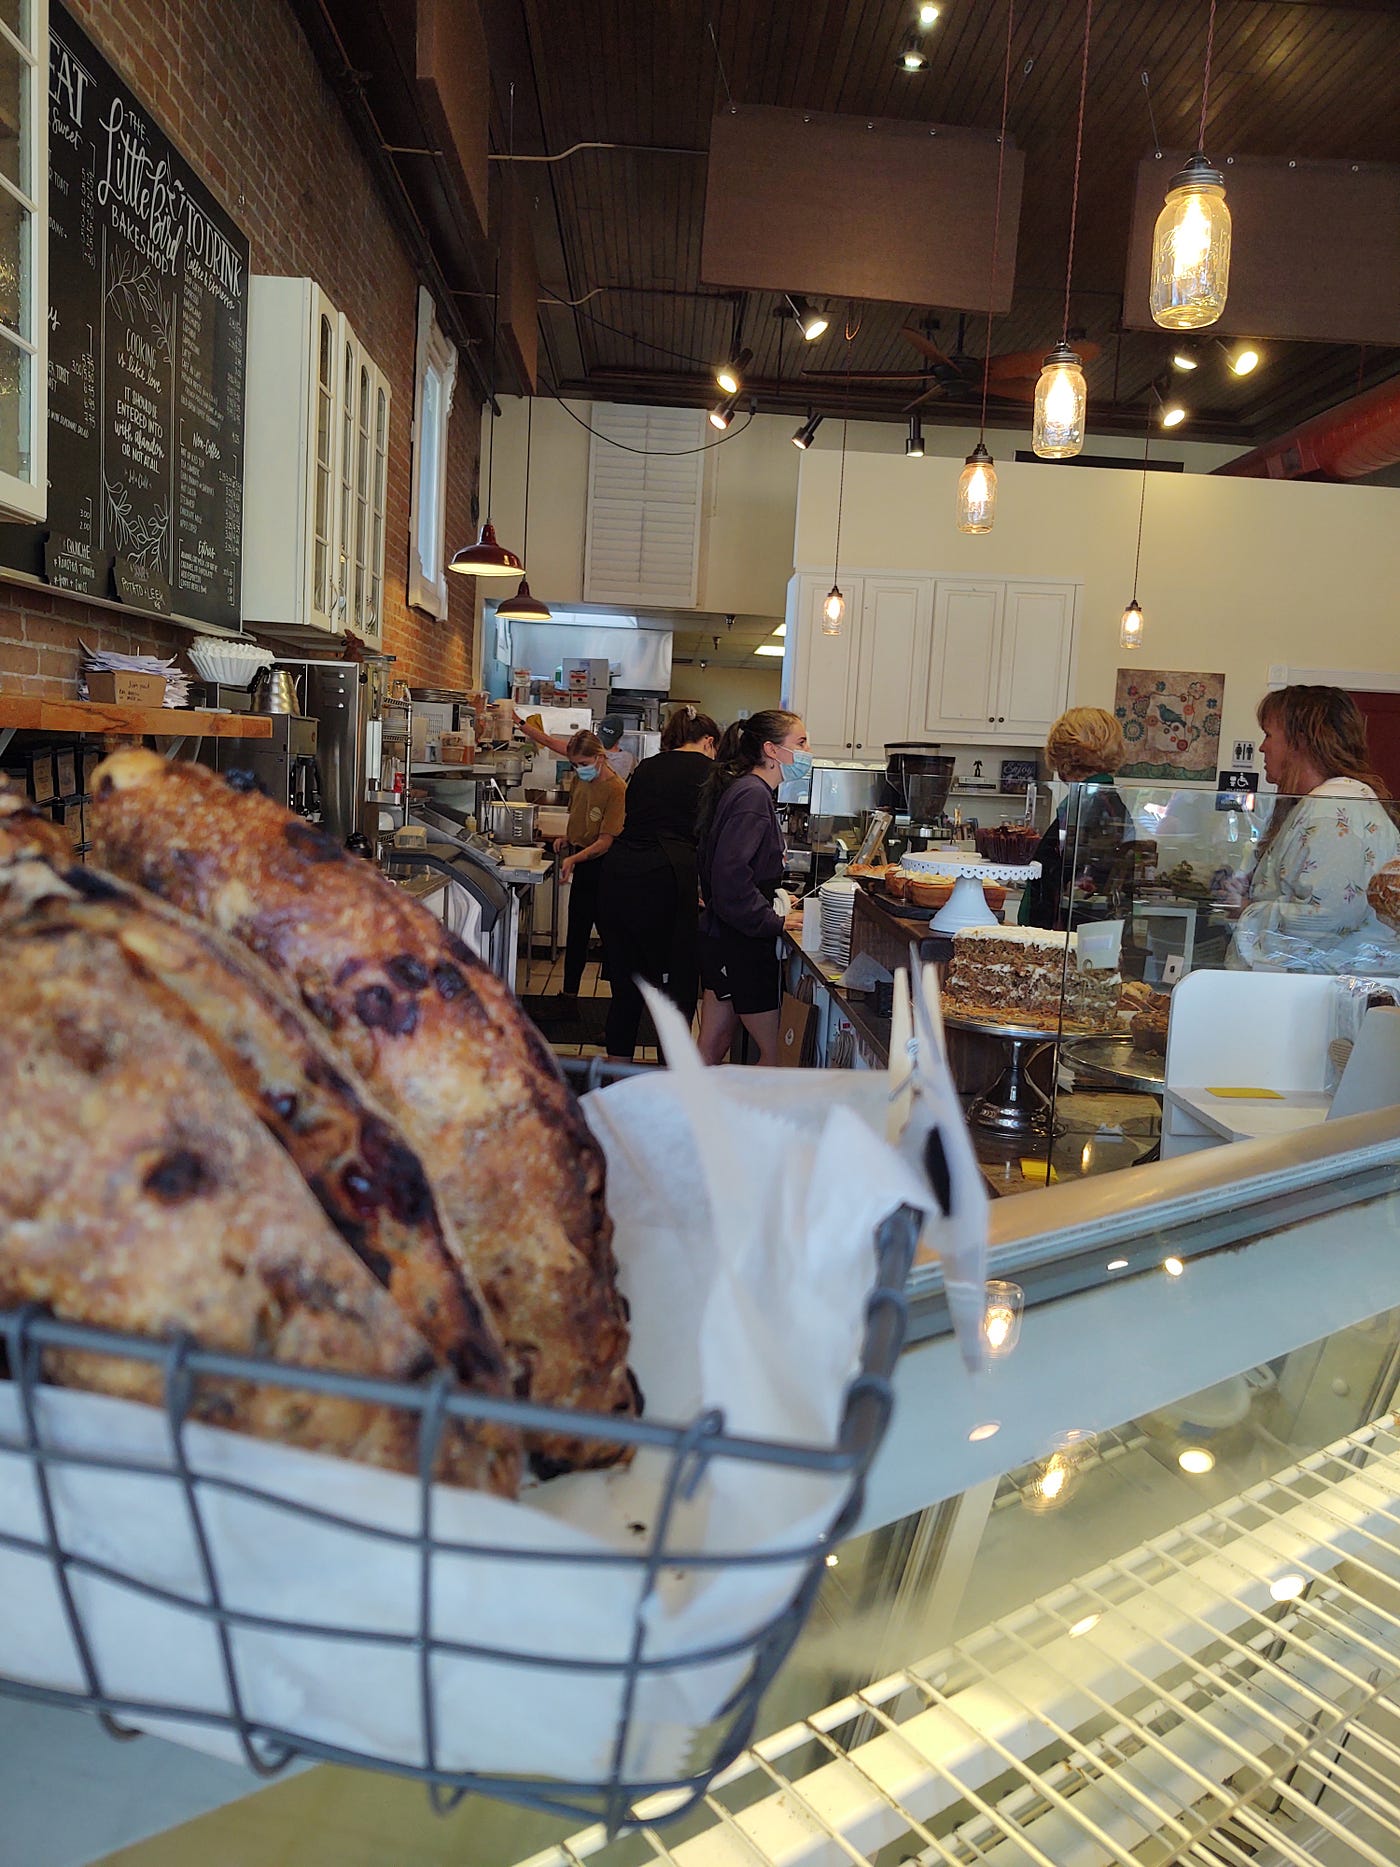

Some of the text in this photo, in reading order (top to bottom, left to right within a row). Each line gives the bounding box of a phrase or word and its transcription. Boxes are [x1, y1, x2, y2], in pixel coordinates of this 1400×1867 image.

[128, 111, 147, 141] THE
[98, 97, 153, 221] Little
[112, 204, 170, 276] BAKESHOP
[186, 200, 204, 255] TO
[205, 222, 242, 298] DRINK
[126, 328, 156, 371] COOKING
[125, 386, 131, 402] IT
[127, 354, 146, 381] like
[146, 369, 162, 394] love
[117, 399, 163, 439] ENTERED INTO
[122, 443, 131, 457] OR
[132, 447, 144, 465] NOT
